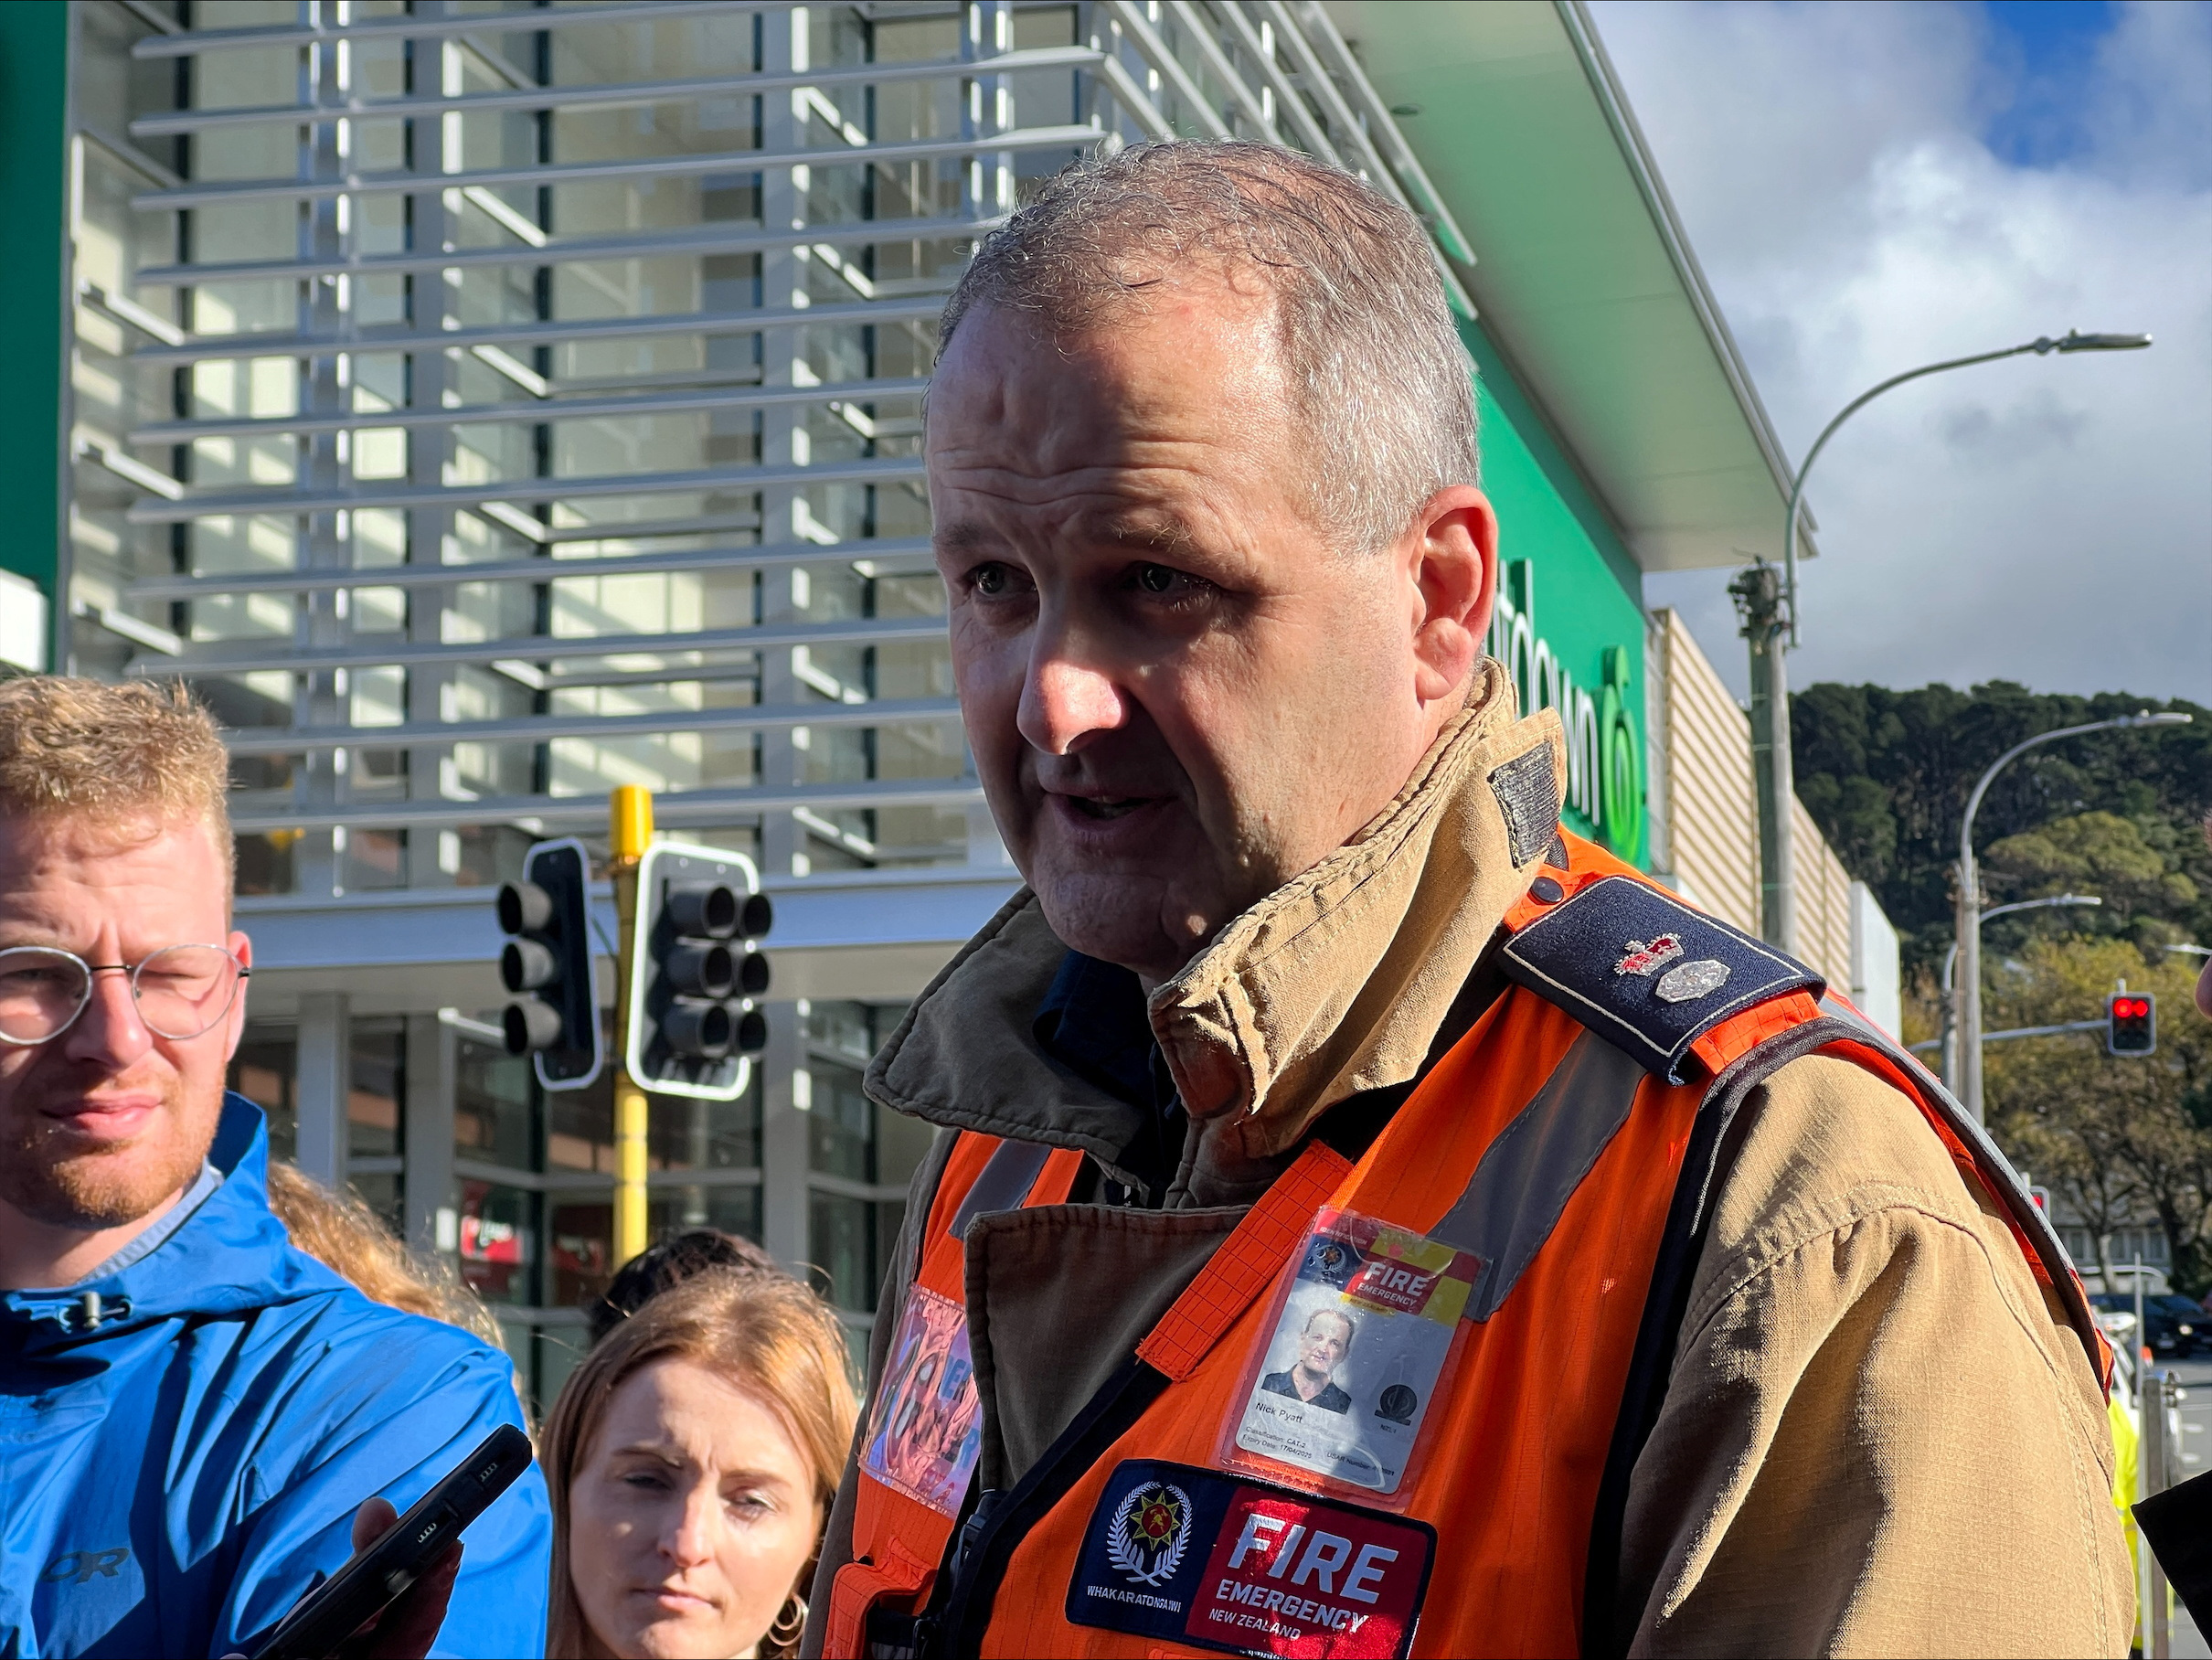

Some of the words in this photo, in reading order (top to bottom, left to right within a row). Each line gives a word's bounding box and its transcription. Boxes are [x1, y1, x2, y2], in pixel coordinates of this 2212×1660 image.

[1357, 1282, 1418, 1306] EMERGENCY
[1363, 1261, 1430, 1297] FIRE
[1255, 1402, 1276, 1416] Nick
[1278, 1409, 1303, 1423] Pyatt
[44, 1547, 130, 1583] OR
[1228, 1513, 1399, 1604] FIRE
[1208, 1609, 1235, 1624] NEW
[1237, 1613, 1302, 1640] ZEALAND
[1216, 1580, 1369, 1633] EMERGENCY
